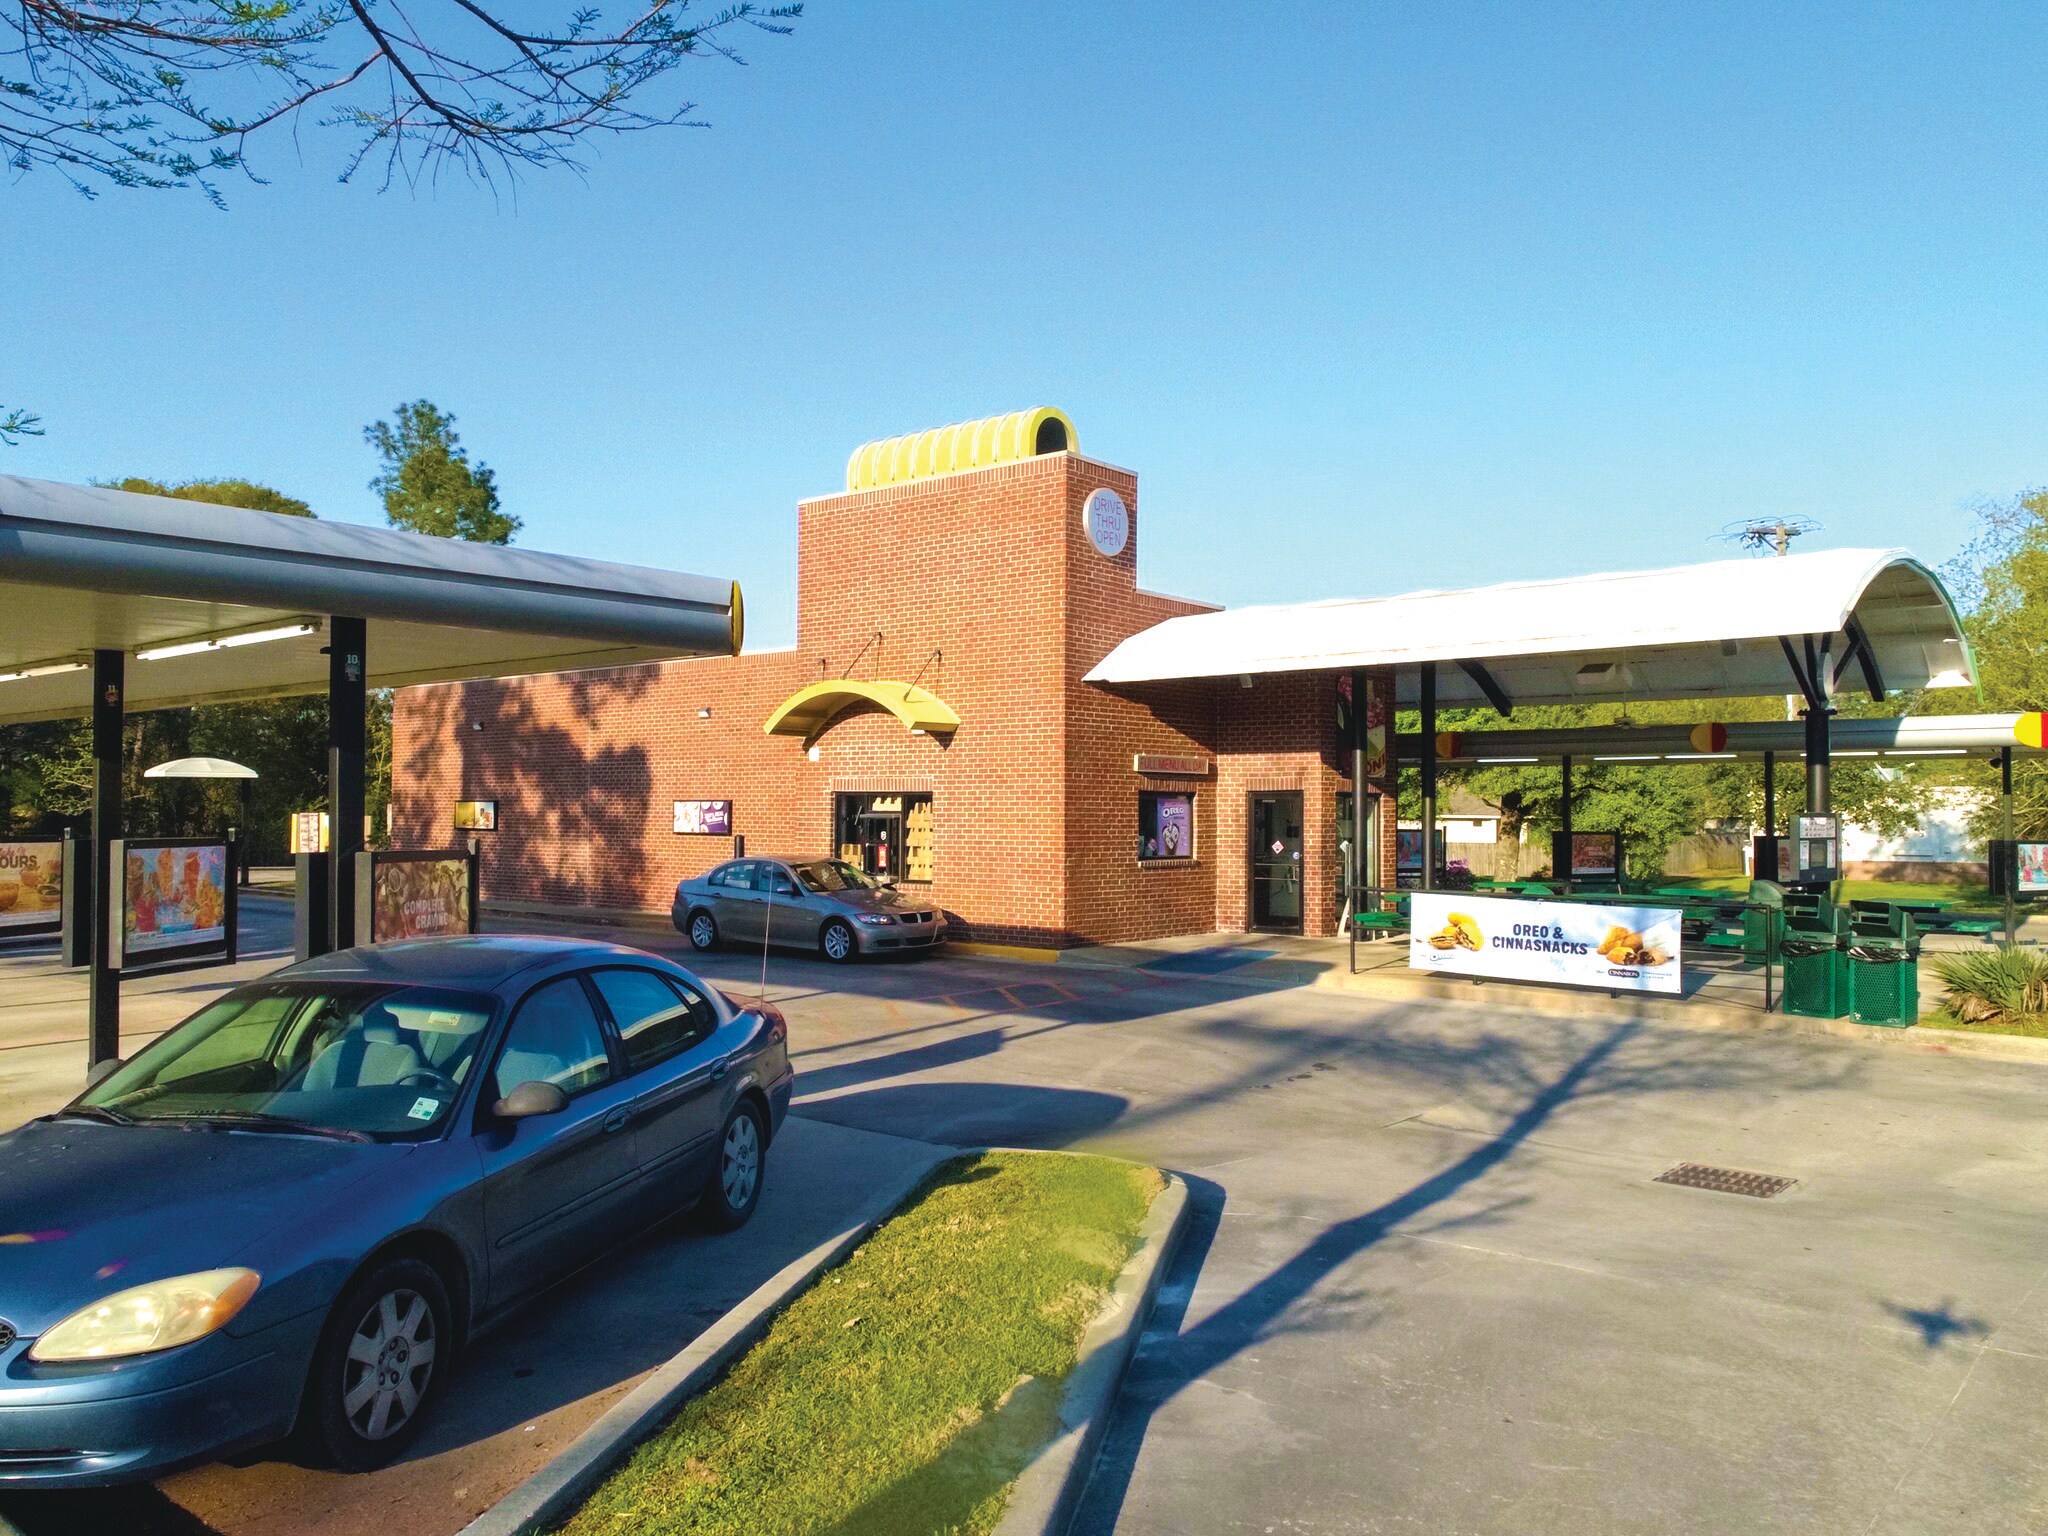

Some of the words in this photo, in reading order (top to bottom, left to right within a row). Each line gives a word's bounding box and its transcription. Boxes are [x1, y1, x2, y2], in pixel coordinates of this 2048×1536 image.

[1094, 497, 1122, 515] DRIVE
[1096, 513, 1121, 531] THRU
[1096, 530, 1121, 547] OPEN
[347, 654, 358, 664] 10
[1141, 757, 1158, 769] FULL
[1158, 758, 1179, 771] MENU
[1180, 760, 1192, 771] ALL
[1162, 806, 1184, 818] OREO
[404, 898, 445, 914] COMPLETE
[1513, 924, 1549, 938] OREO
[1553, 926, 1564, 939] &
[1492, 936, 1588, 955] CINNASNACKS
